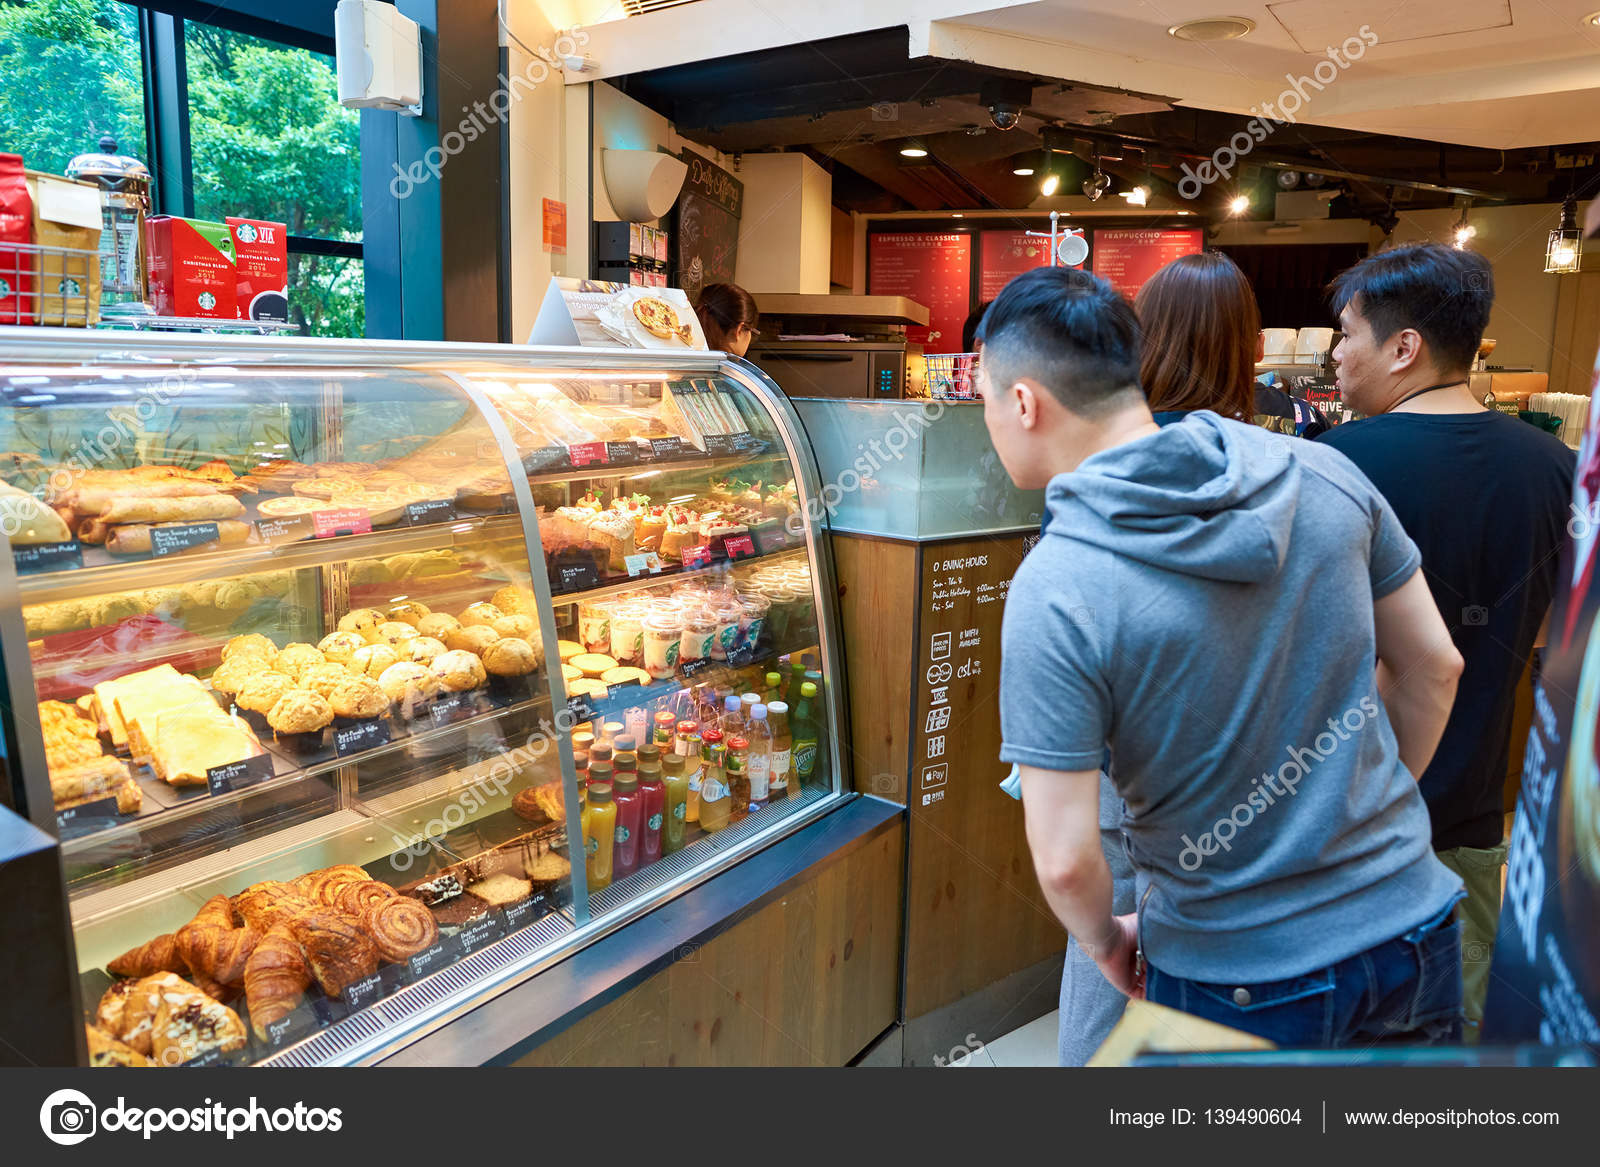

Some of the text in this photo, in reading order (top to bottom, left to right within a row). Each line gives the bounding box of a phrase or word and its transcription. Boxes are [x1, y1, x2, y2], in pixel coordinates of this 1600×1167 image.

[260, 230, 274, 241] VIA
[1104, 232, 1160, 241] FRAPPUCCINO
[1012, 238, 1049, 246] TEAVANA
[1319, 401, 1343, 412] GIVE
[933, 555, 988, 572] OENING HOURS
[949, 587, 971, 598] Holiday
[957, 657, 972, 679] csl
[933, 691, 946, 701] VISA
[932, 770, 945, 781] Pay
